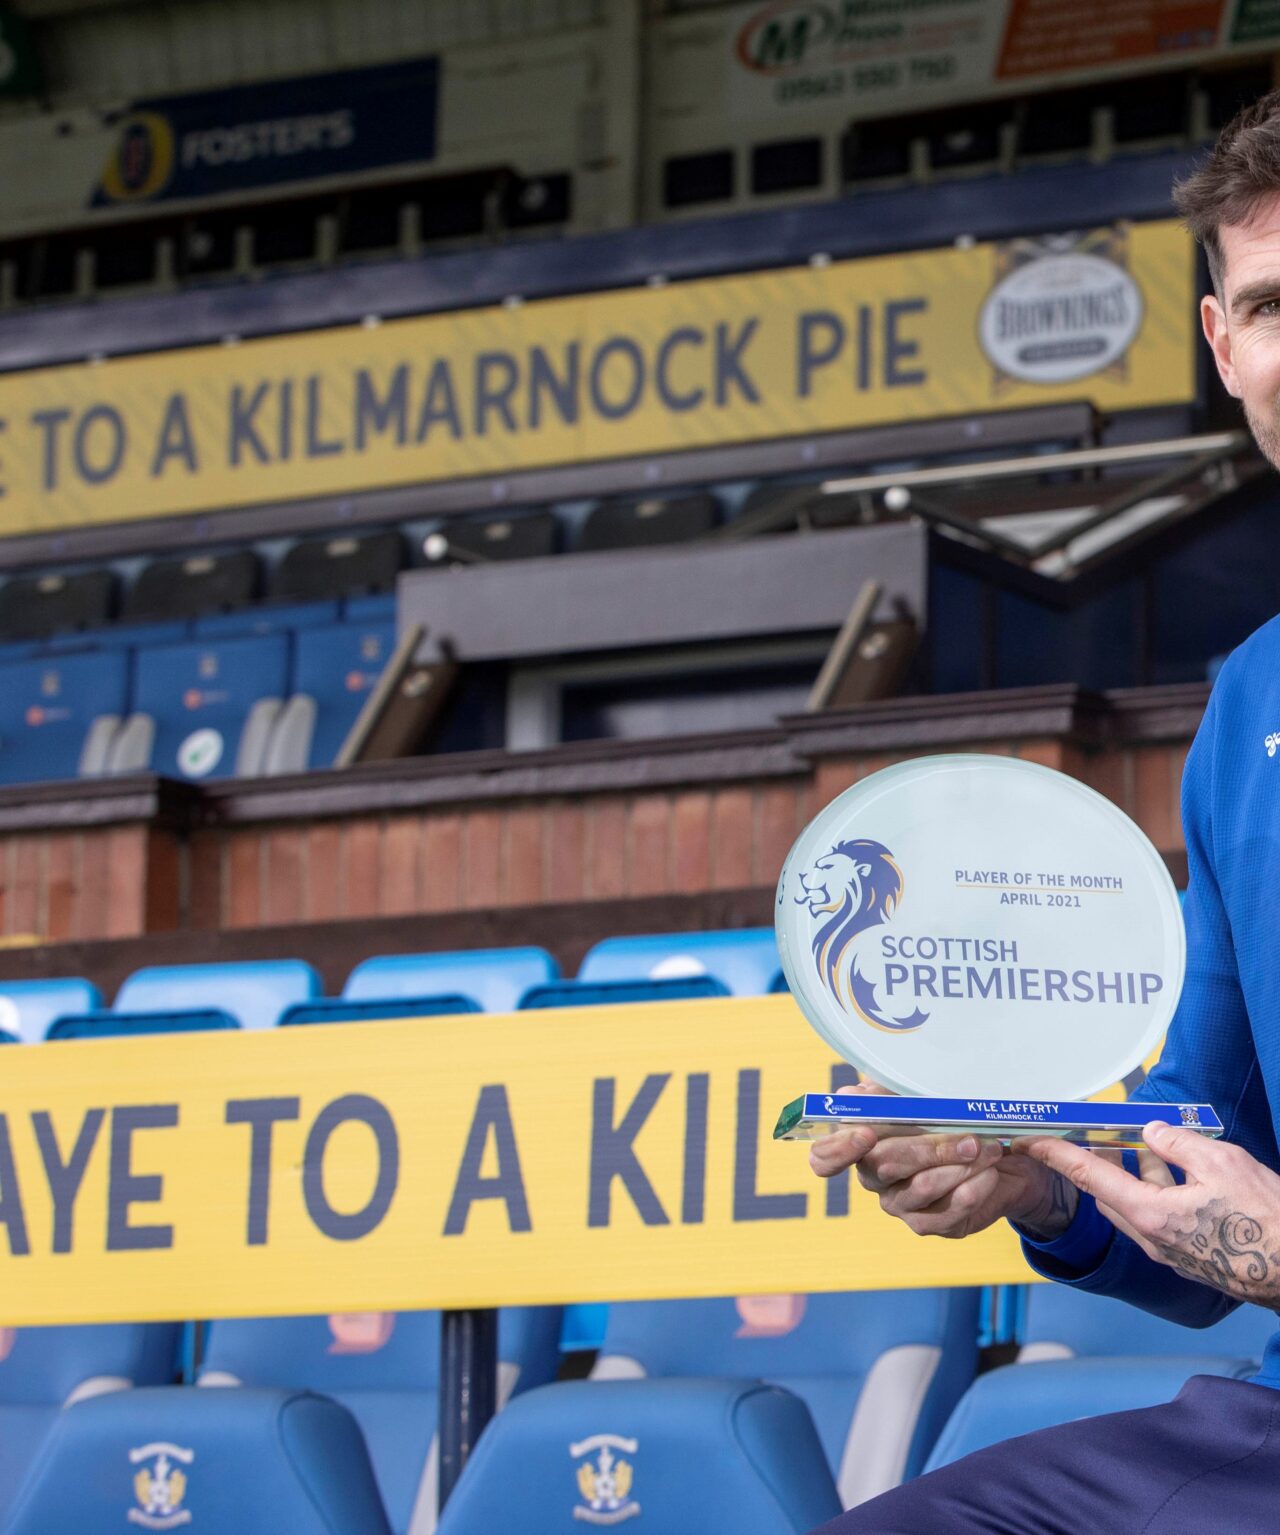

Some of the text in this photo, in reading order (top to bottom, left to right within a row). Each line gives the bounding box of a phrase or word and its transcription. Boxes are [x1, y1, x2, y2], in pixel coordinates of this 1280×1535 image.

[31, 403, 127, 492] TO
[151, 391, 198, 478] A
[228, 315, 762, 468] KILMARNOCK
[797, 299, 926, 399] PIE
[955, 870, 1123, 889] PLAYER OF THE MONTH
[1000, 892, 1081, 908] APRIL 2021
[881, 935, 1018, 962] SCOTTISH
[884, 963, 1164, 1005] PREMIERSHIP
[967, 1101, 1059, 1114] KYLE LAFFERTY
[986, 1113, 1032, 1121] KILMARNOCK
[225, 1091, 399, 1247] TO
[442, 1084, 533, 1237] A
